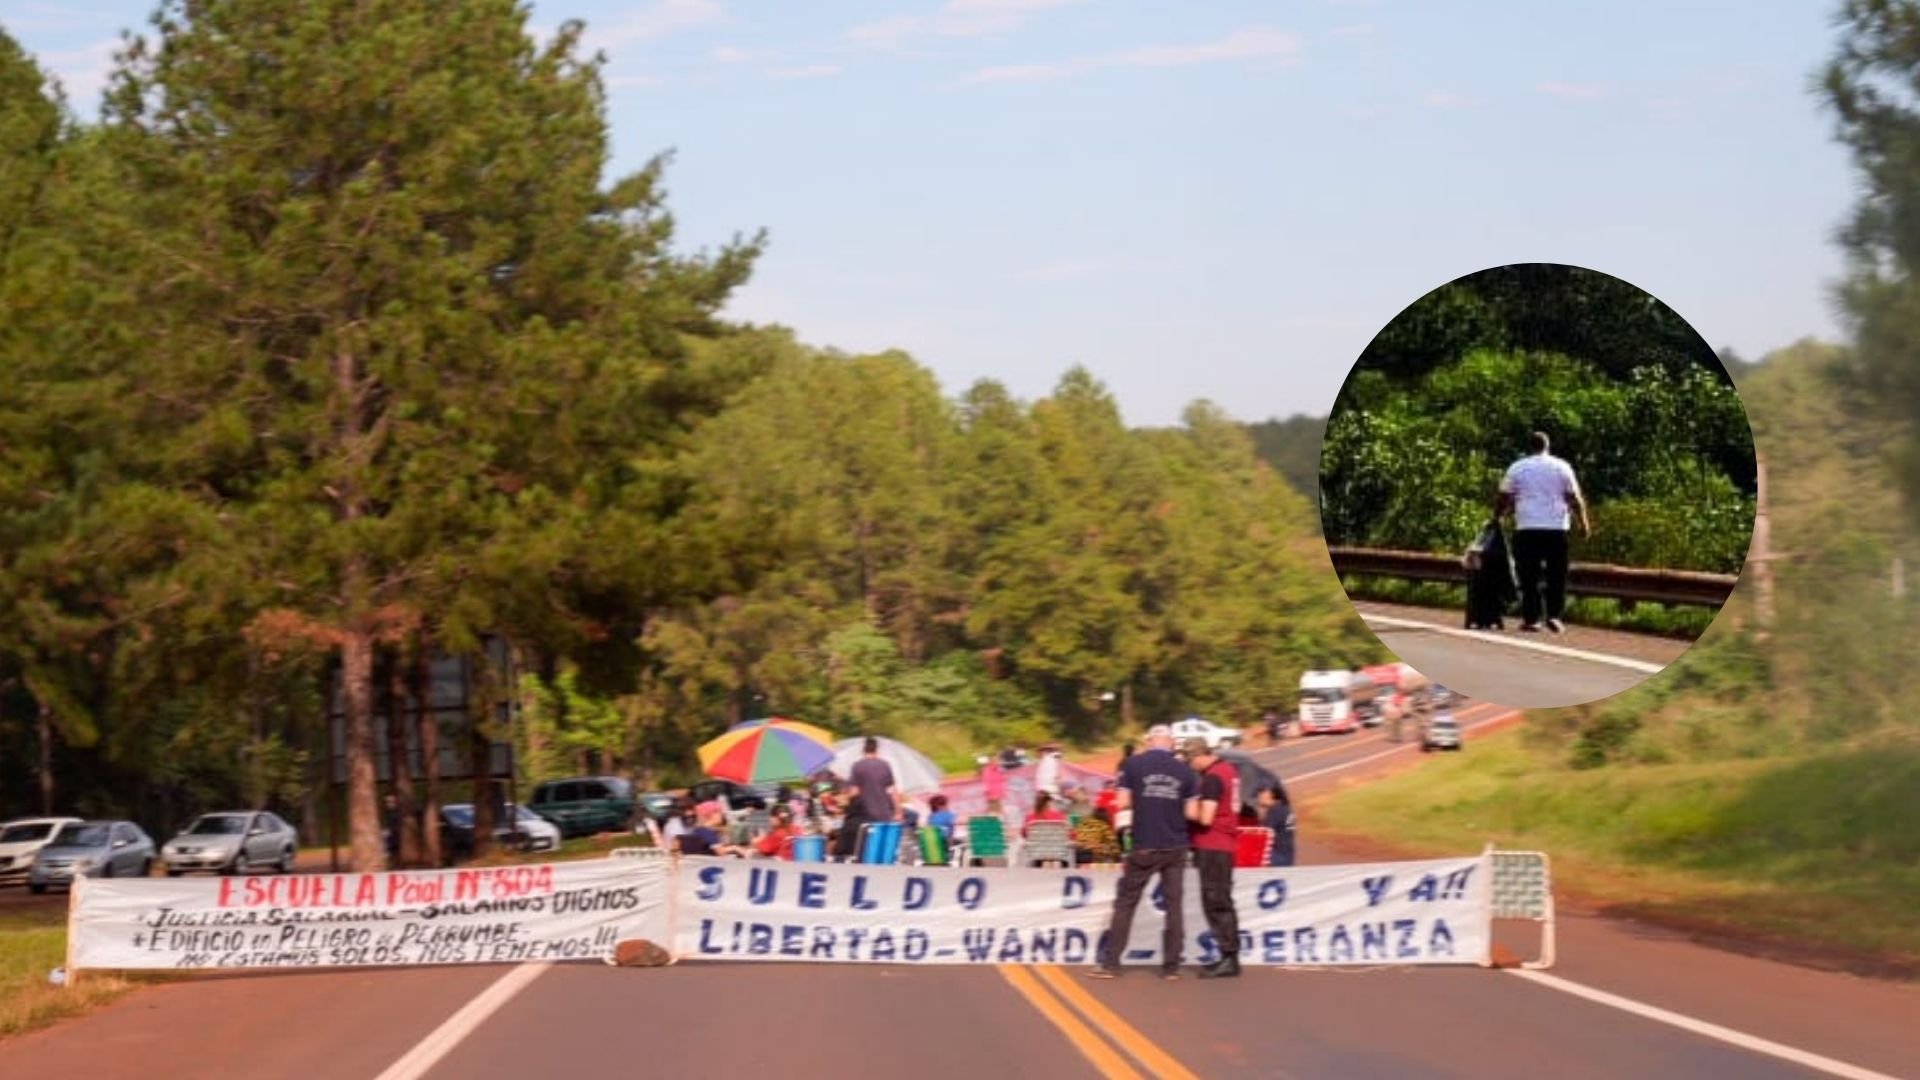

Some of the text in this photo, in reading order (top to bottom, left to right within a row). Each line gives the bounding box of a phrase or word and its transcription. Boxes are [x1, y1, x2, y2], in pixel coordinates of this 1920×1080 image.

[219, 875, 375, 907] ESCUELA
[552, 887, 639, 914] DIGNOS
[694, 866, 988, 910] SUELDO
